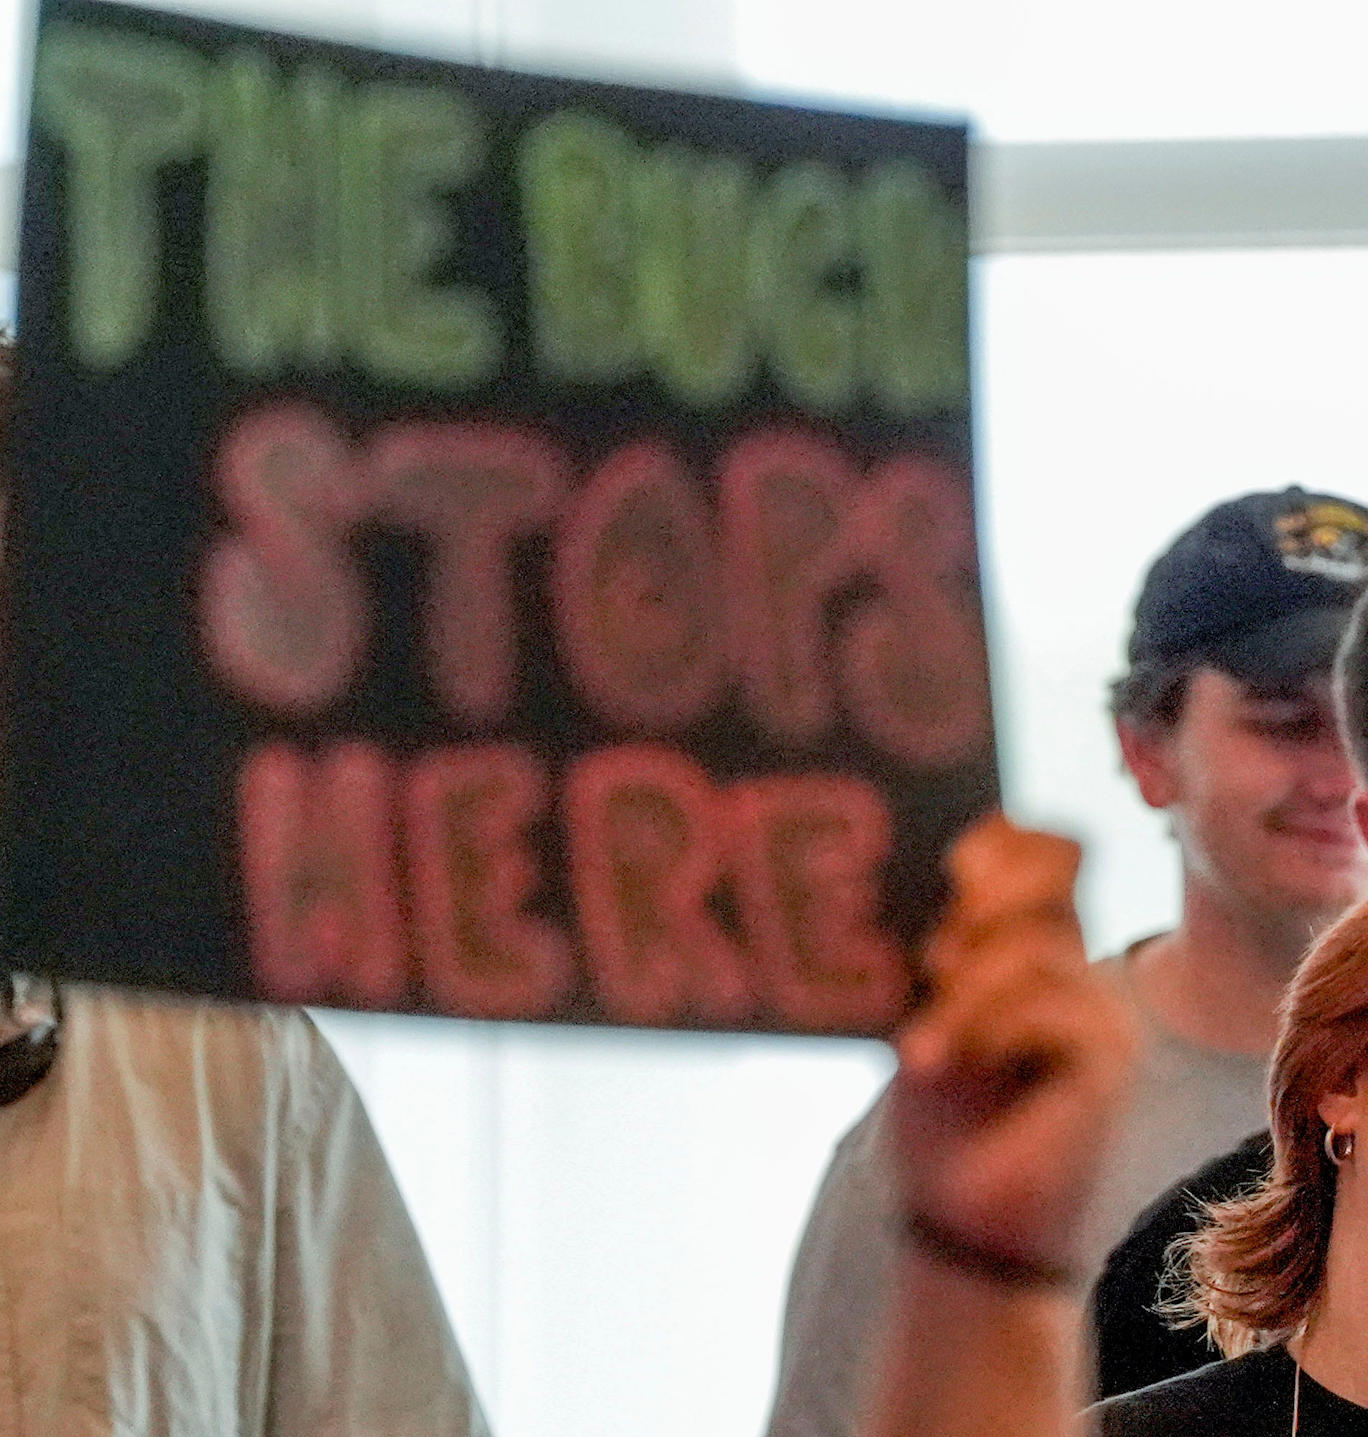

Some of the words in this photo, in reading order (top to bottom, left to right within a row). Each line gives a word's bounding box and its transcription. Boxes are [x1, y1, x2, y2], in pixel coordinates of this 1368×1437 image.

[38, 28, 498, 387] THE
[205, 404, 990, 764] STOPS
[240, 742, 908, 1022] HERE
